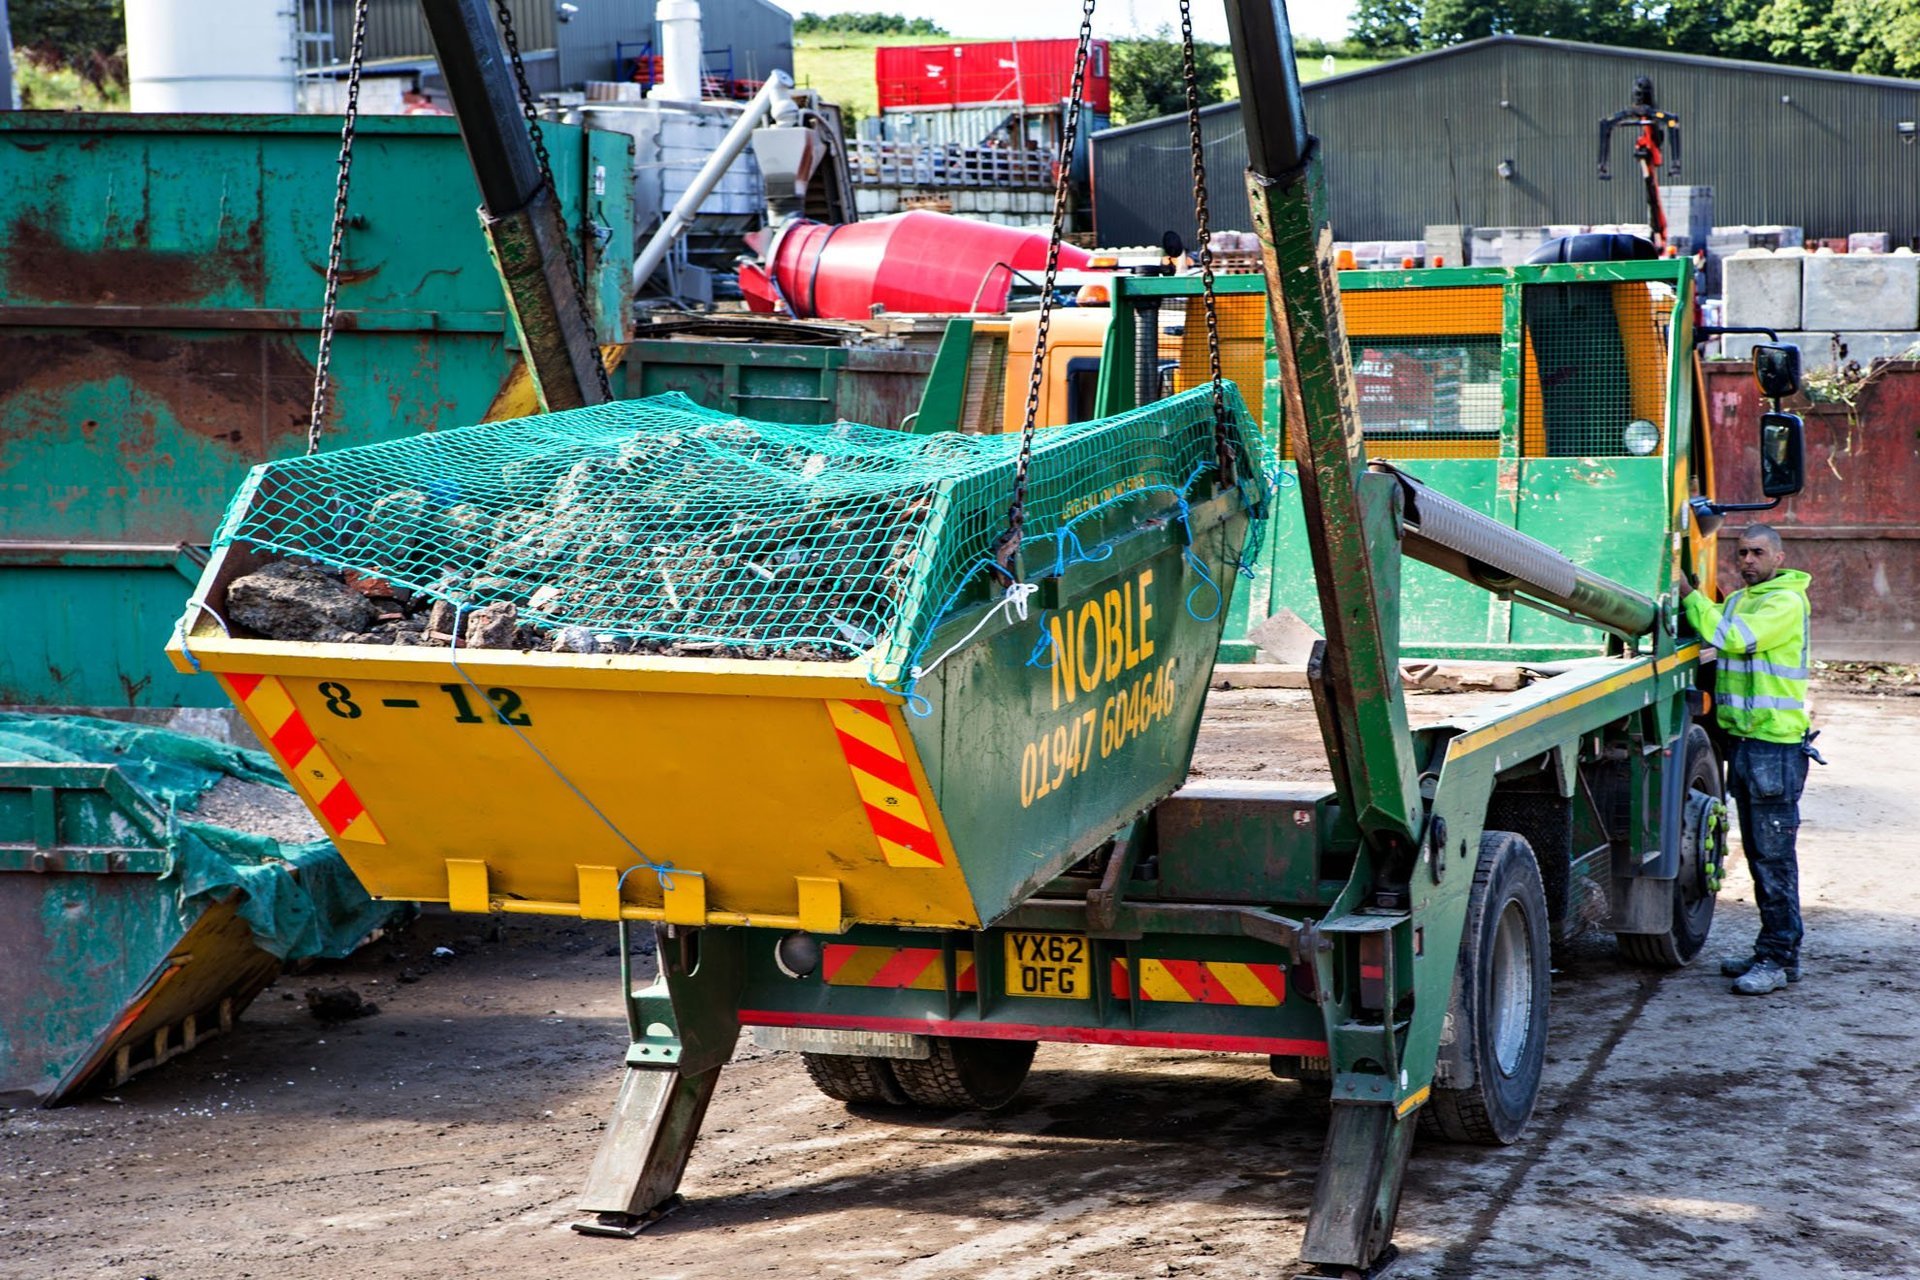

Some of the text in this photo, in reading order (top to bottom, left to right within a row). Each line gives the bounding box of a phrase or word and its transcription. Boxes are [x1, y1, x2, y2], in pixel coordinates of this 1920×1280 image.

[1051, 569, 1154, 711] NOBLE
[318, 681, 362, 719] 8
[440, 683, 533, 727] 12
[1021, 657, 1176, 808] 01947 604646
[1012, 934, 1083, 963] YX62
[1022, 966, 1074, 993] OFG
